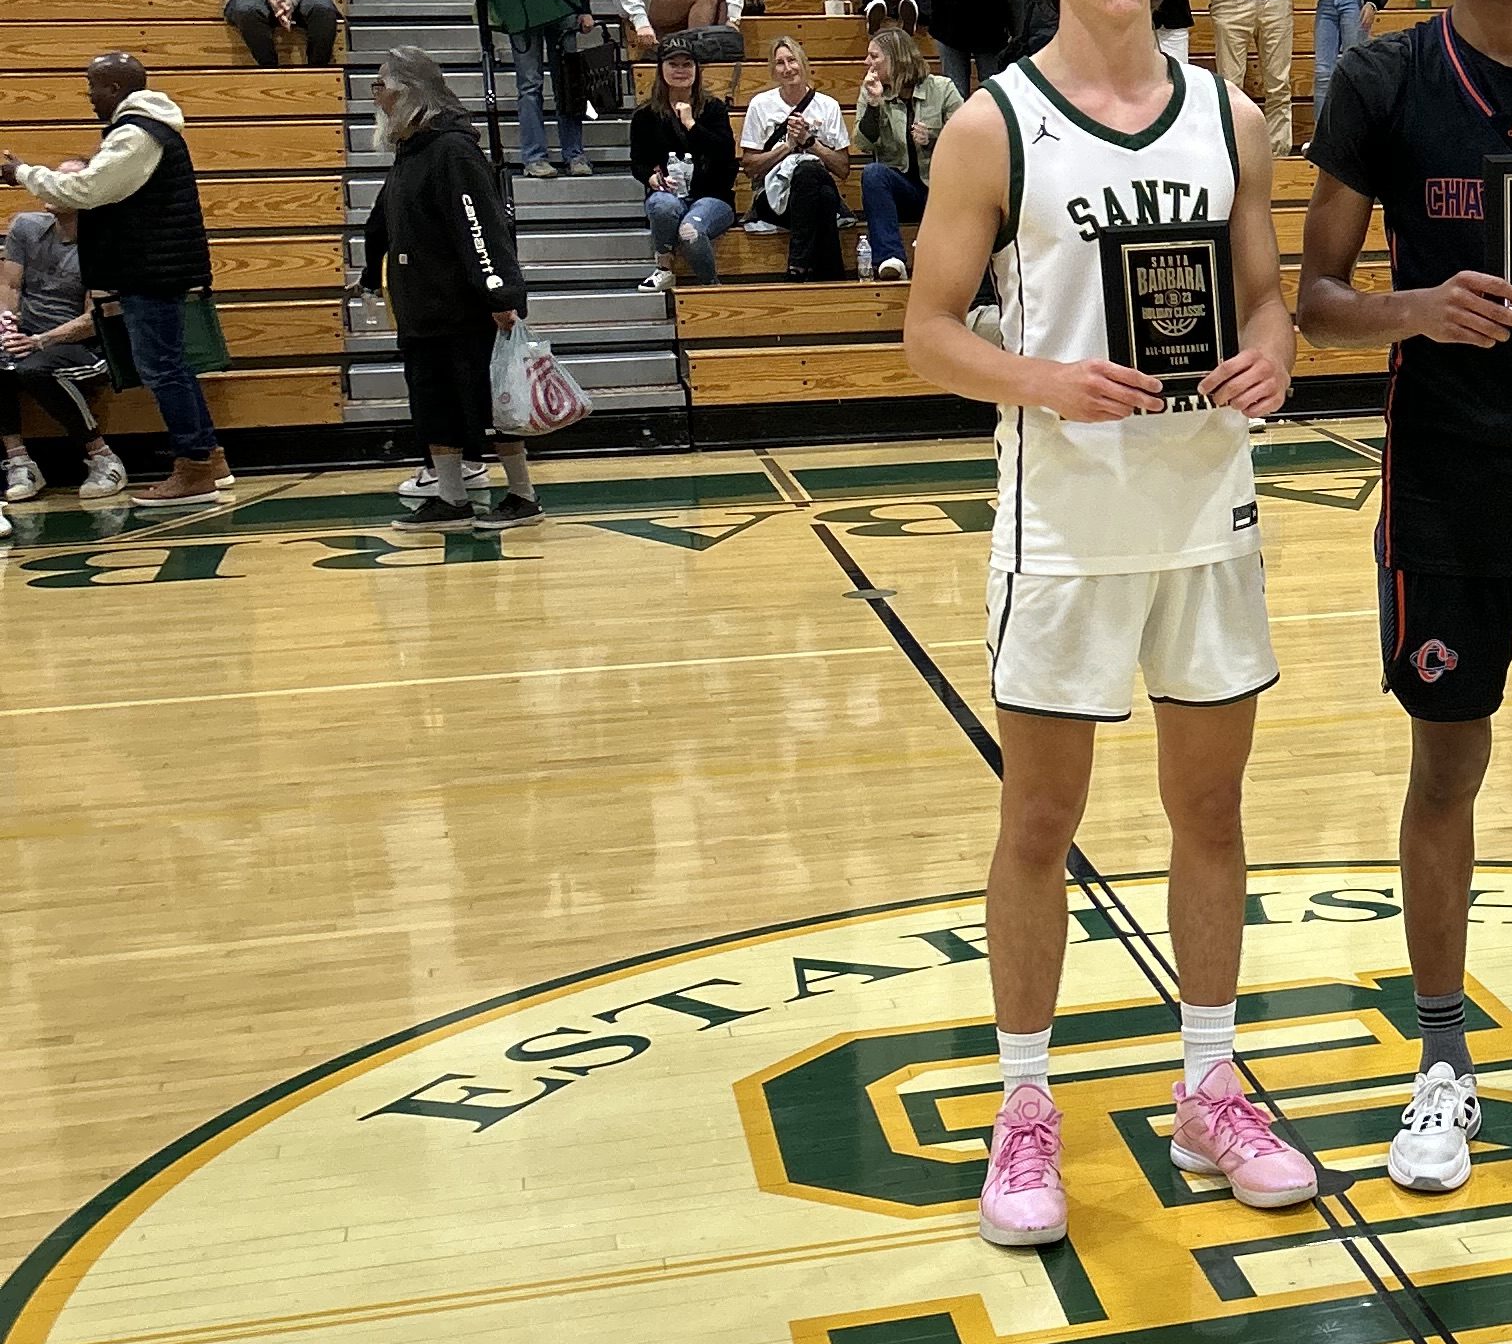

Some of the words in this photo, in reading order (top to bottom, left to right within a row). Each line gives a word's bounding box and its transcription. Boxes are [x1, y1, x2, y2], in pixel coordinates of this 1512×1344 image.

[1066, 179, 1210, 243] SANTA
[1425, 177, 1486, 220] CHA
[1136, 263, 1207, 297] BARBARA
